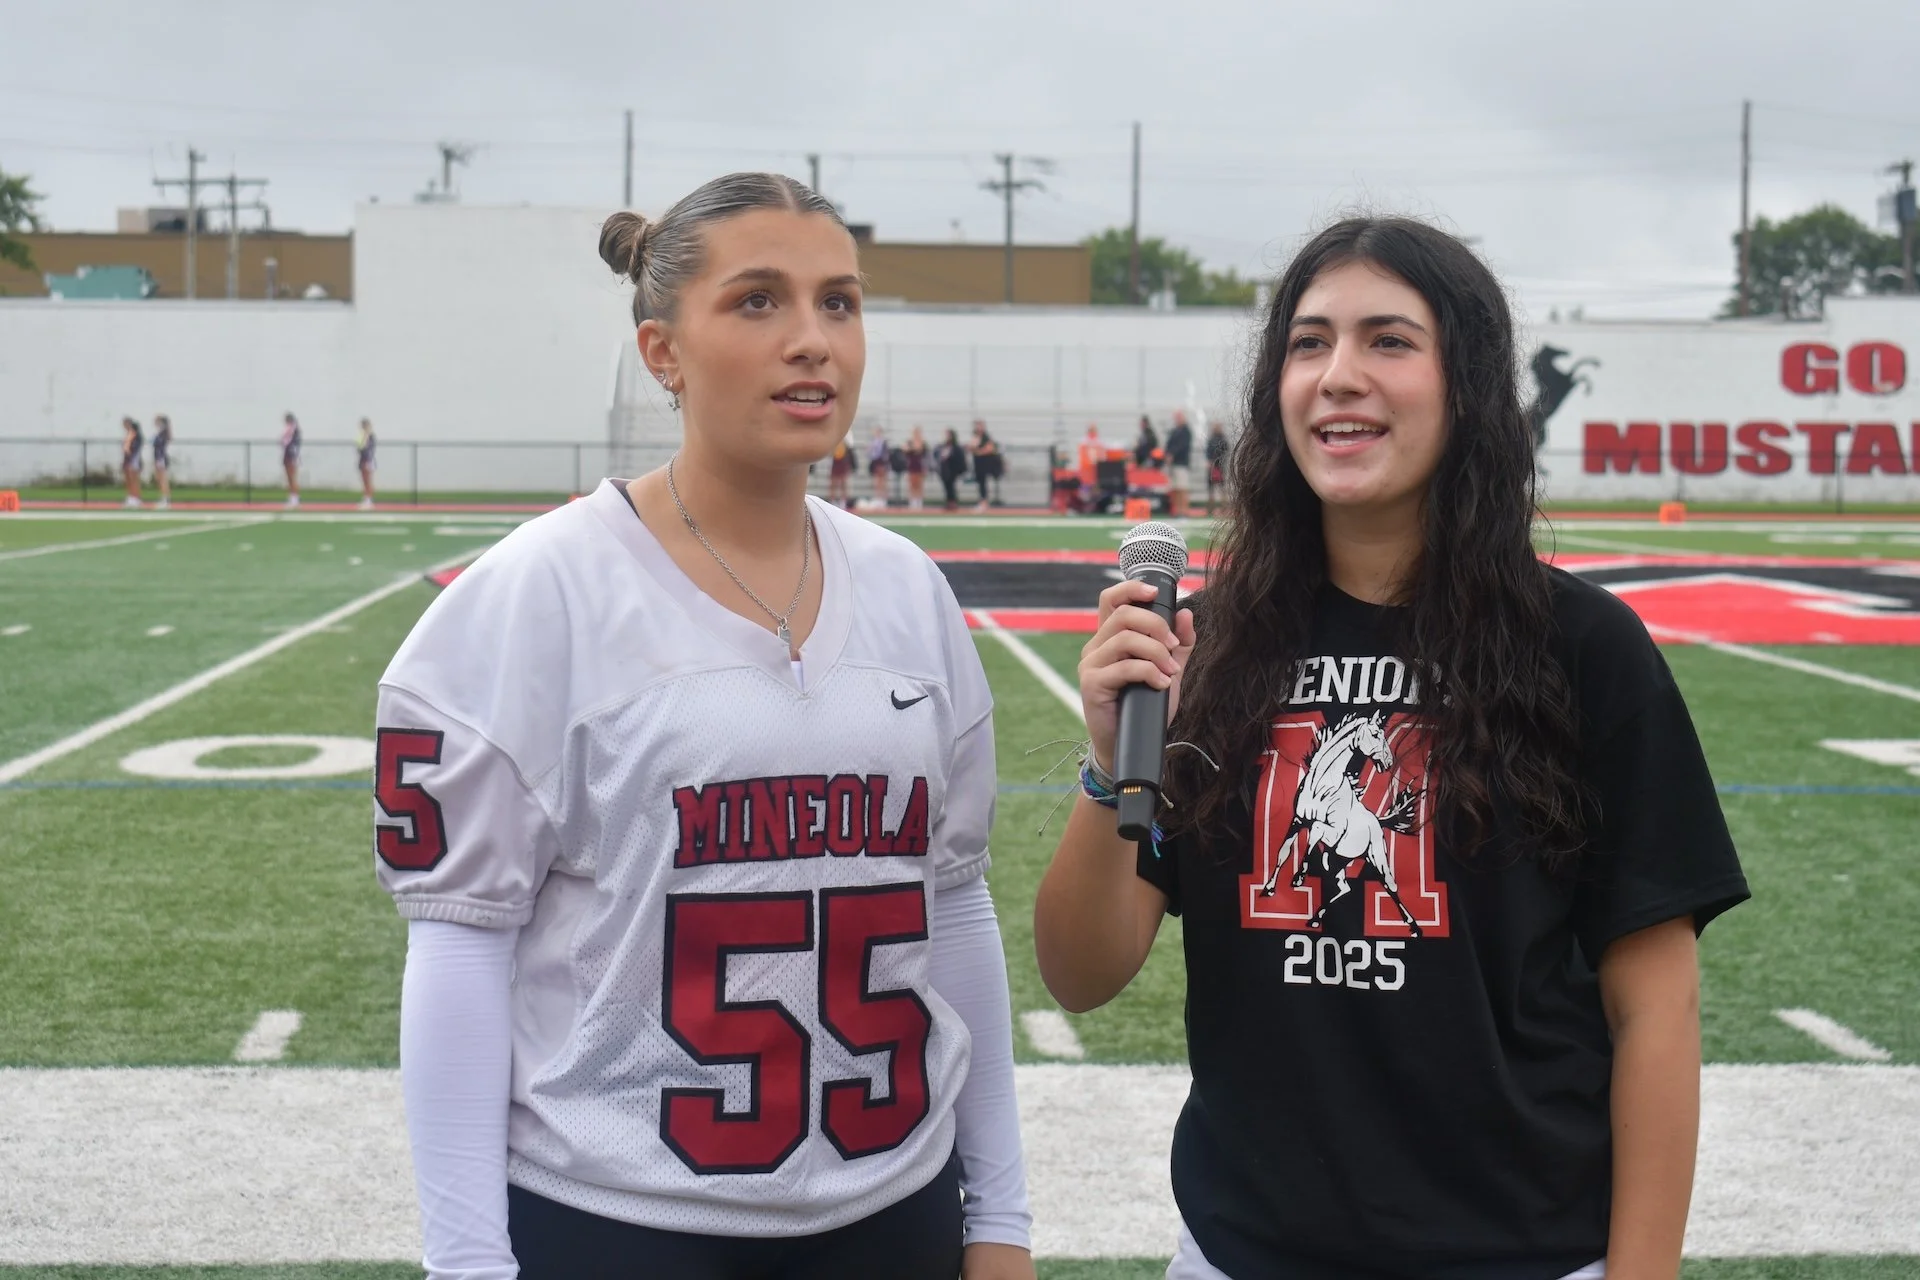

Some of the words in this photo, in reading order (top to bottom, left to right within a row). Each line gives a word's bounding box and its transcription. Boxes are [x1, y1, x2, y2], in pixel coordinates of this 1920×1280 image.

[1781, 341, 1906, 395] GO
[1583, 421, 1920, 476] MUSTA
[374, 727, 448, 871] 5
[673, 774, 929, 868] MINEOLA
[1284, 934, 1405, 990] 2025
[660, 881, 932, 1175] 55
